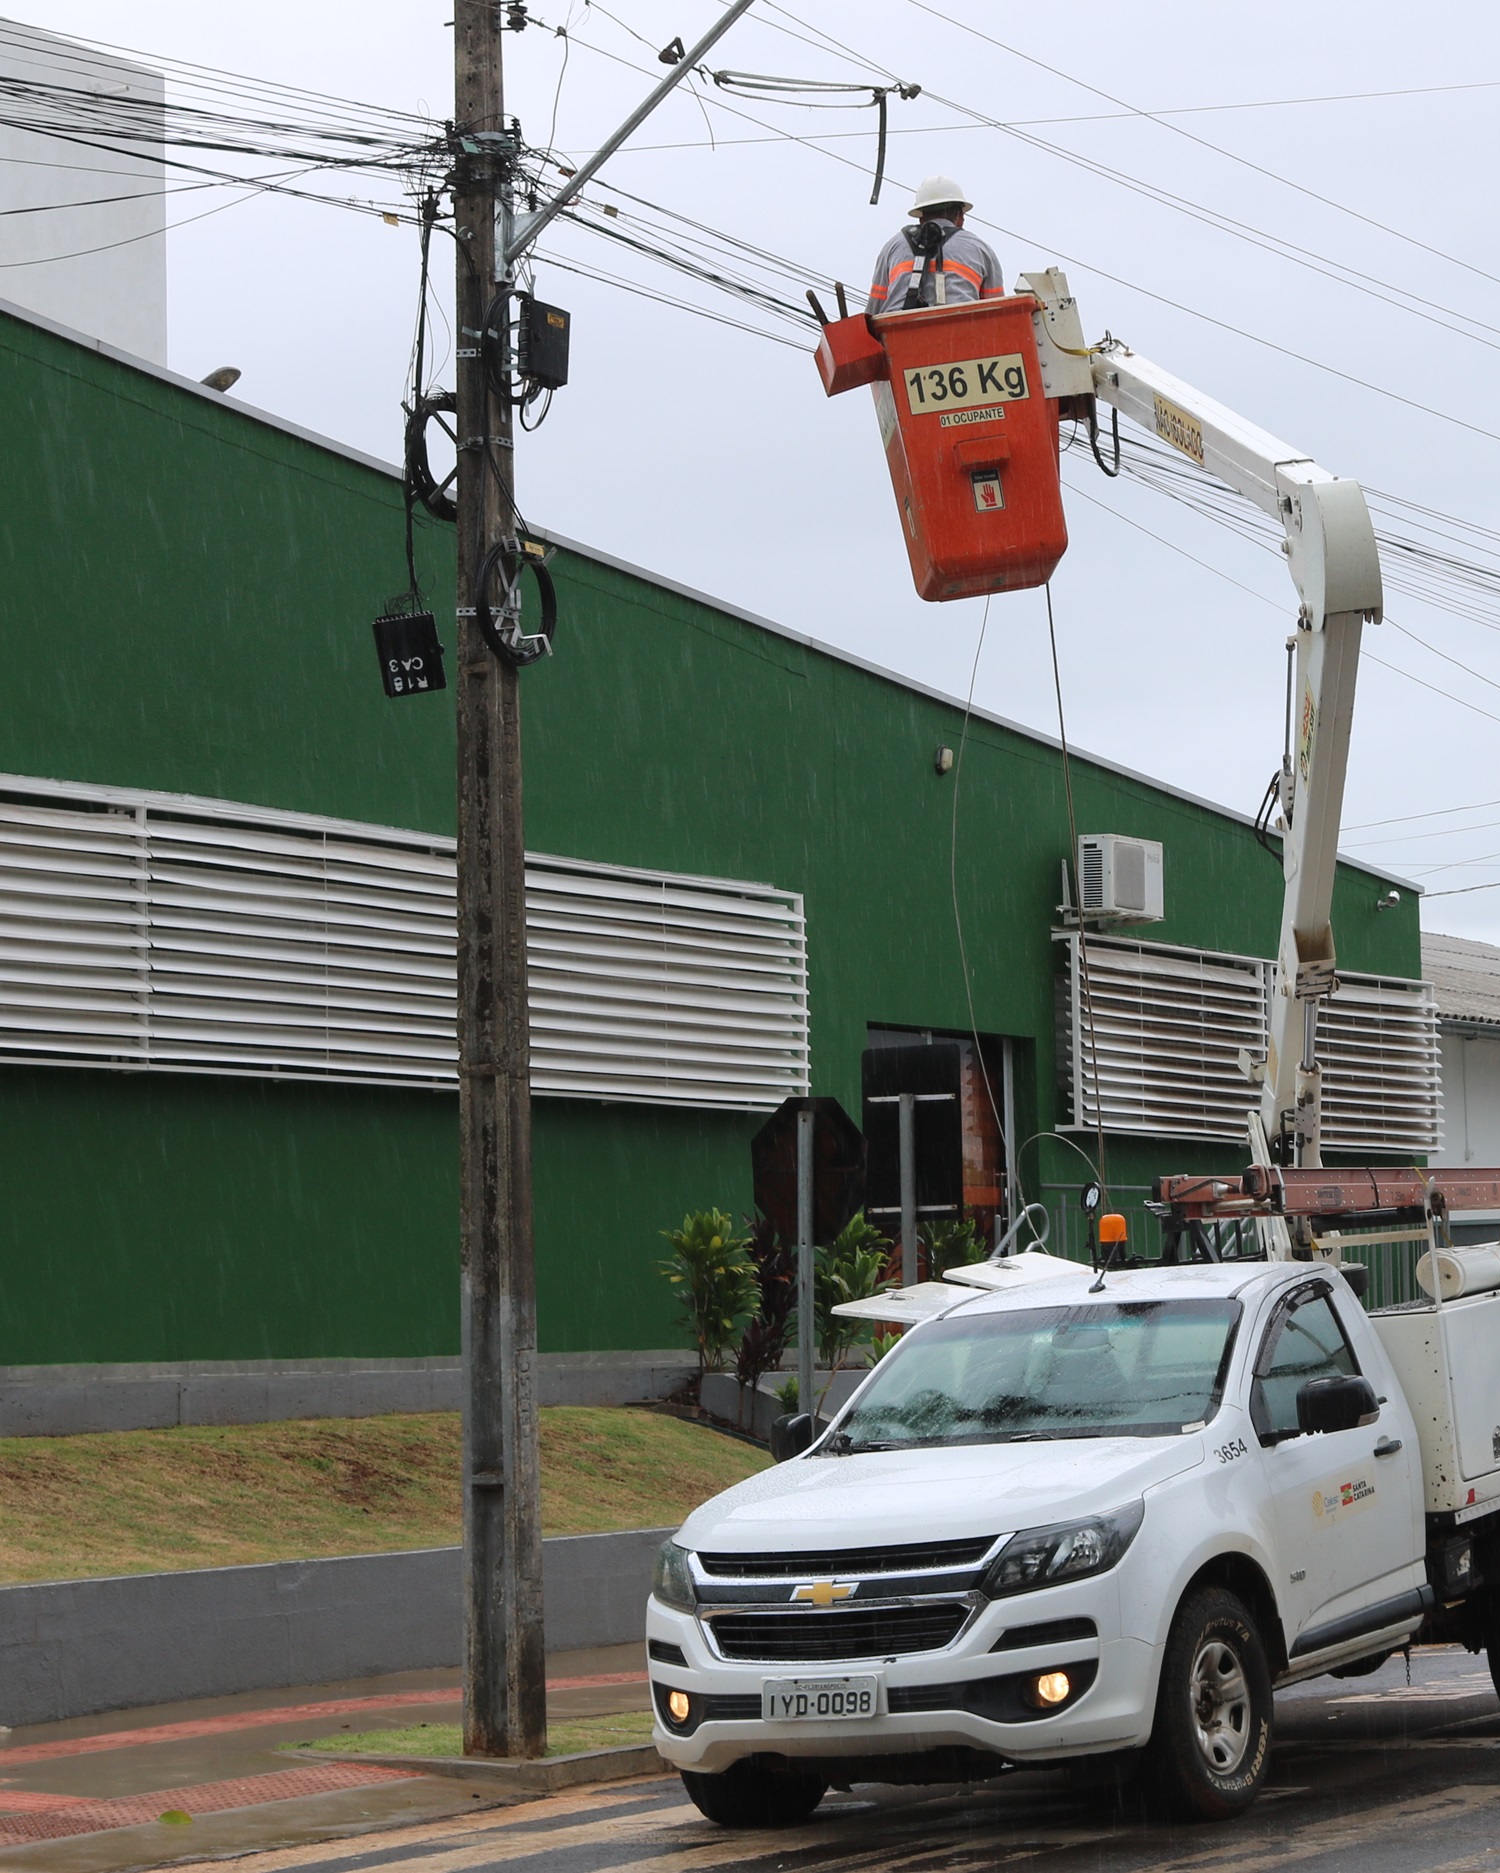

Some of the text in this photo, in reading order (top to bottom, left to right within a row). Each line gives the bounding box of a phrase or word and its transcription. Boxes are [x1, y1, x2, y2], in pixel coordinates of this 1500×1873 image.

[909, 361, 1025, 403] 136 Kg
[941, 408, 1004, 426] 01 OCUPANTE
[1213, 1437, 1248, 1464] 3654
[1352, 1480, 1367, 1493] SANTA
[1353, 1486, 1375, 1502] CATARINA
[1234, 1619, 1250, 1643] T/A
